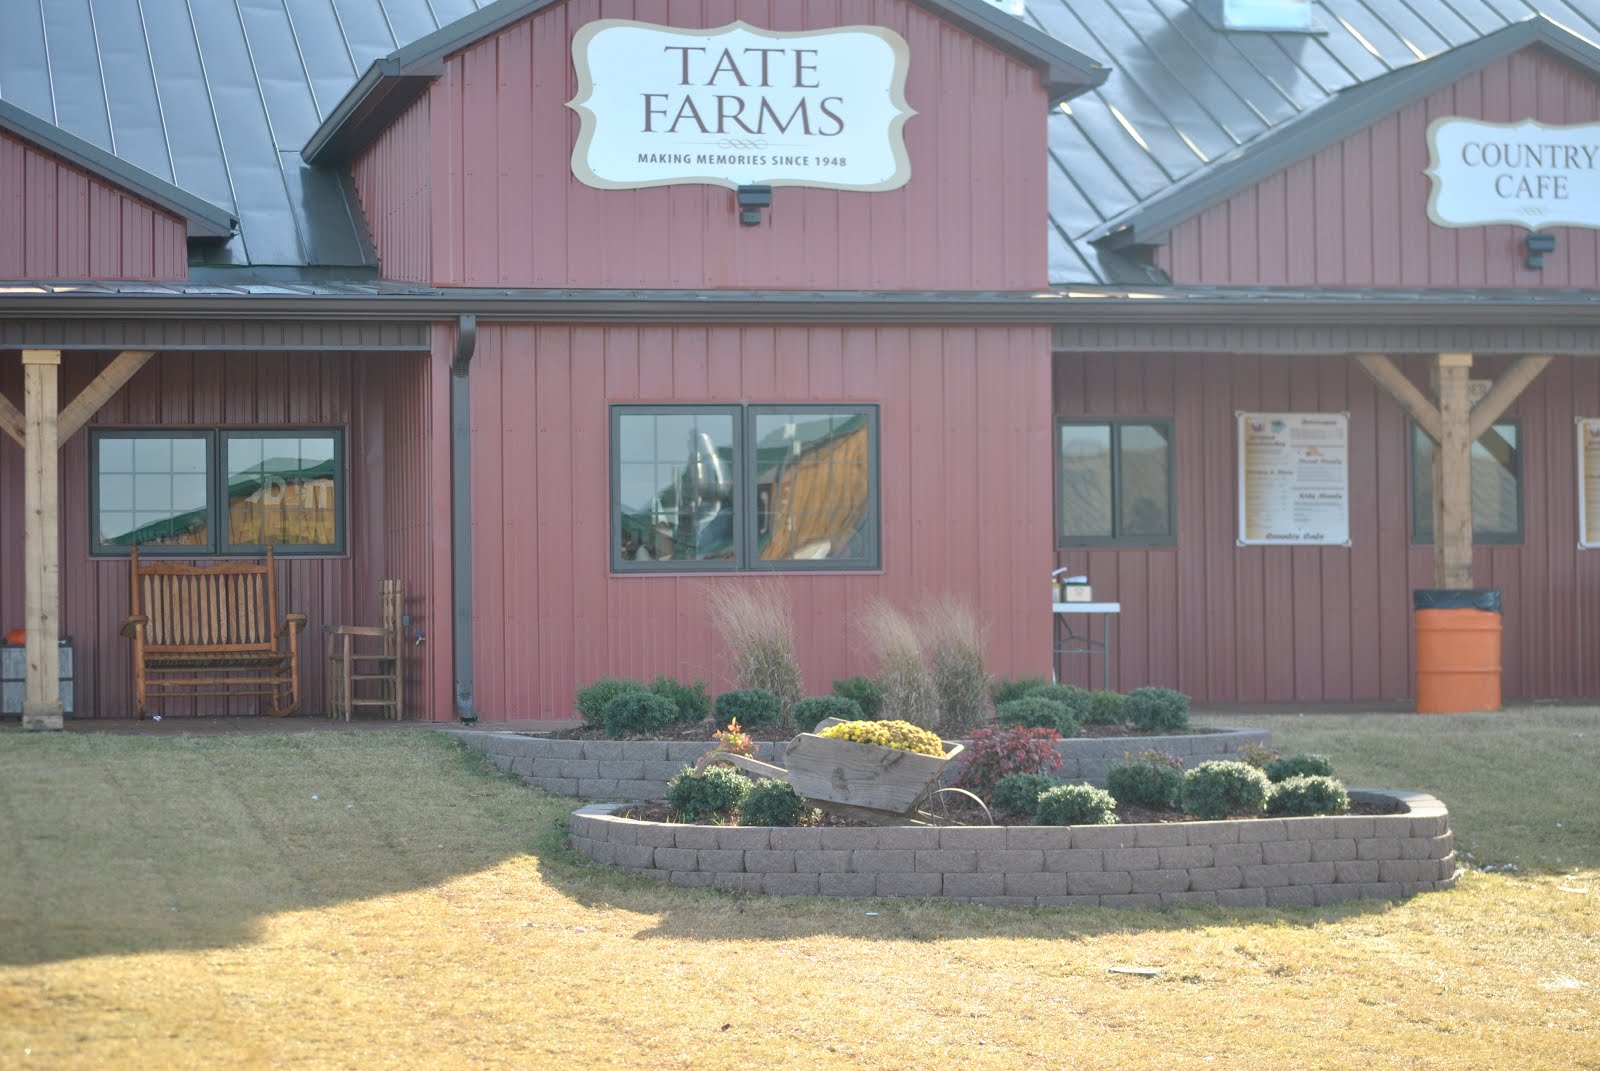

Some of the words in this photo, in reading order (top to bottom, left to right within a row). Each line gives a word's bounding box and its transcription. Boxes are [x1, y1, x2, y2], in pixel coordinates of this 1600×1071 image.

[663, 45, 821, 89] TATE
[639, 92, 846, 137] FARMS
[638, 153, 692, 164] MAKING
[696, 154, 767, 165] MEMORIES
[771, 155, 809, 166] SINCE
[815, 156, 847, 167] 1948
[1461, 142, 1600, 170] COUNTRY
[1494, 173, 1569, 200] CAFE
